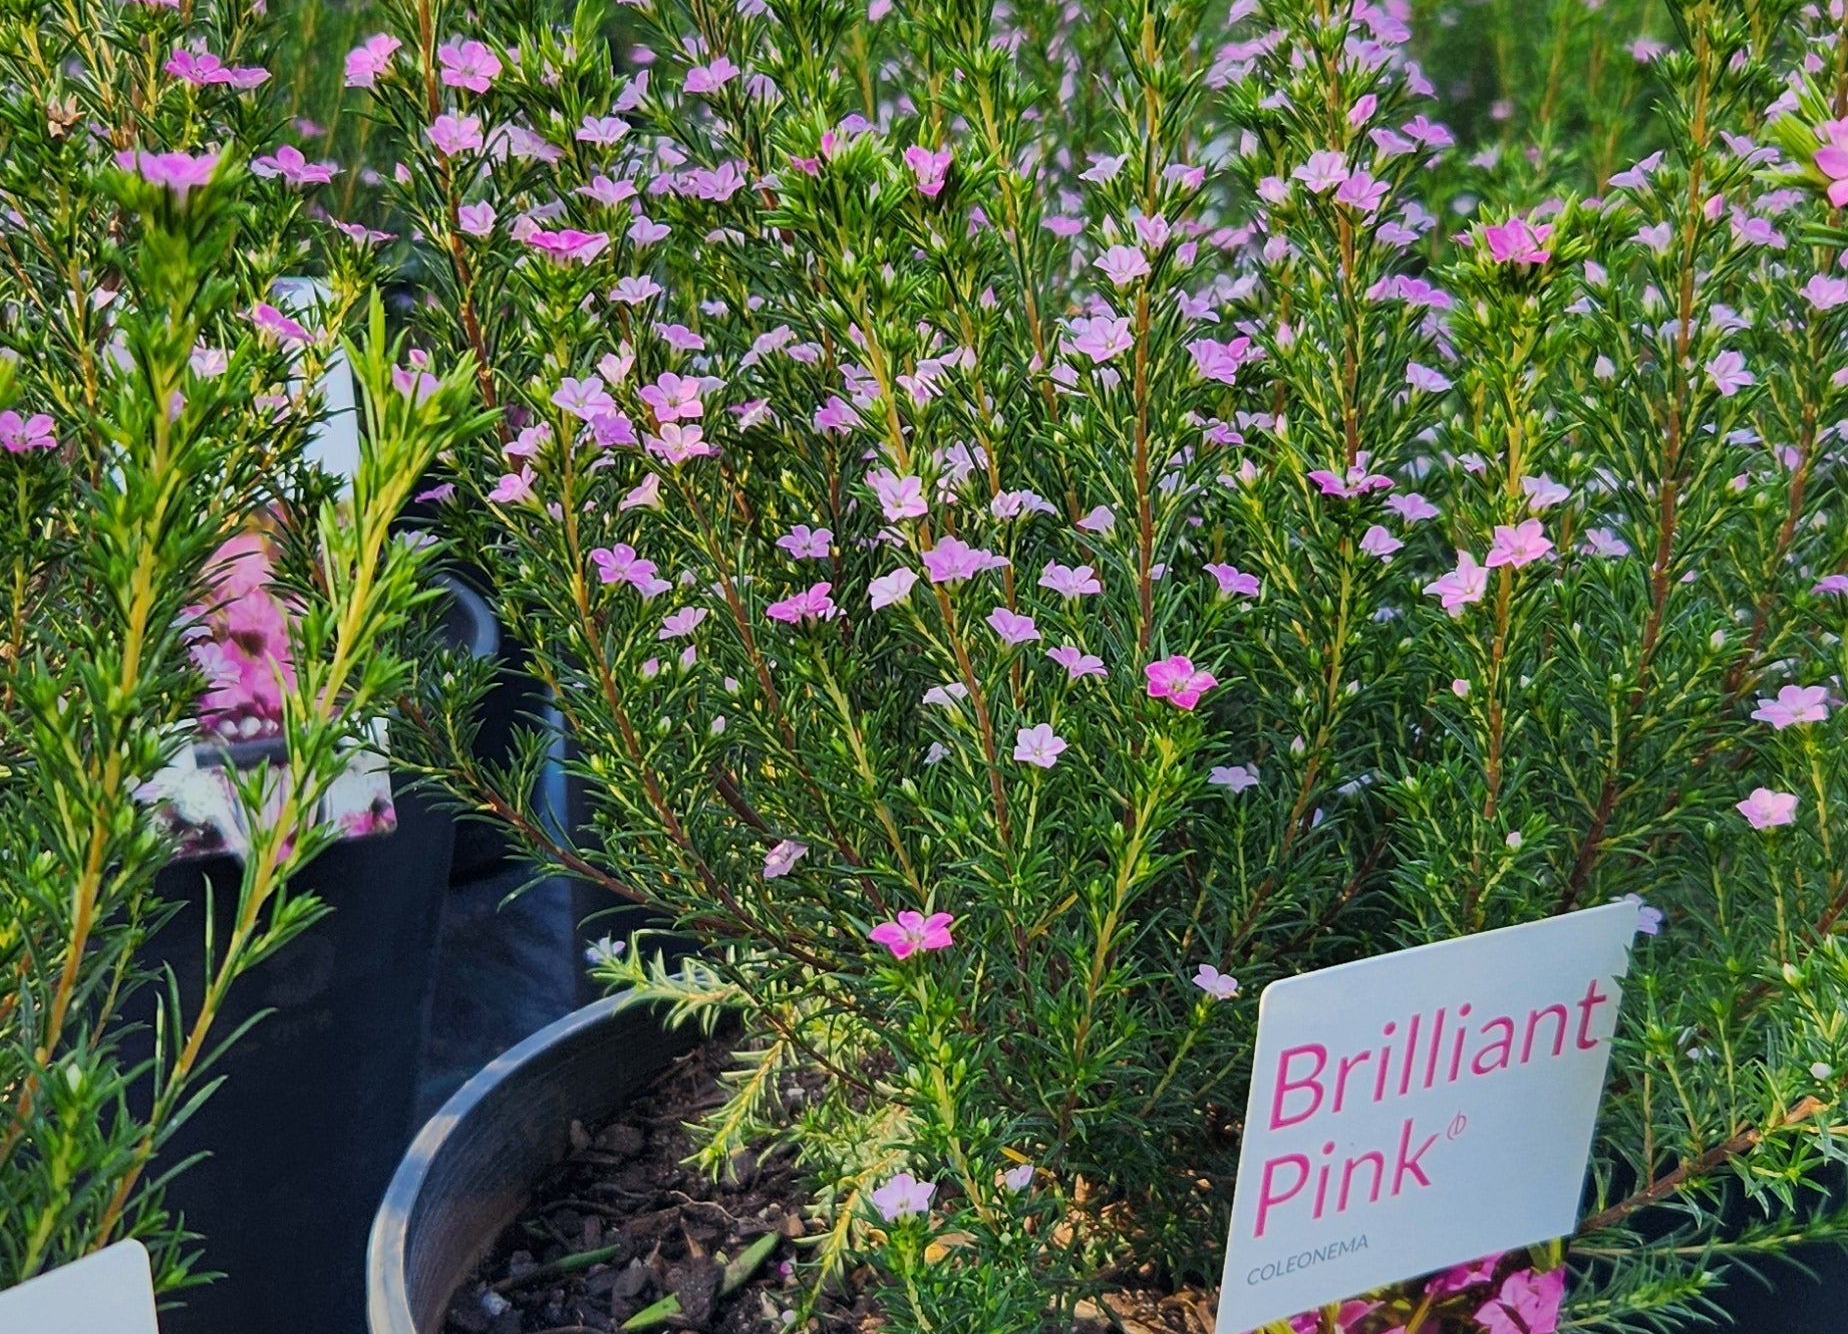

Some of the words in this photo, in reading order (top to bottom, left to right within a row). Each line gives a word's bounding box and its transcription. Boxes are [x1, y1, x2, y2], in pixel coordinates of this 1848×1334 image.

[1269, 979, 1607, 1131] Brilliant
[1252, 1119, 1439, 1238] Pink
[1247, 1234, 1368, 1286] COLEONEMA
